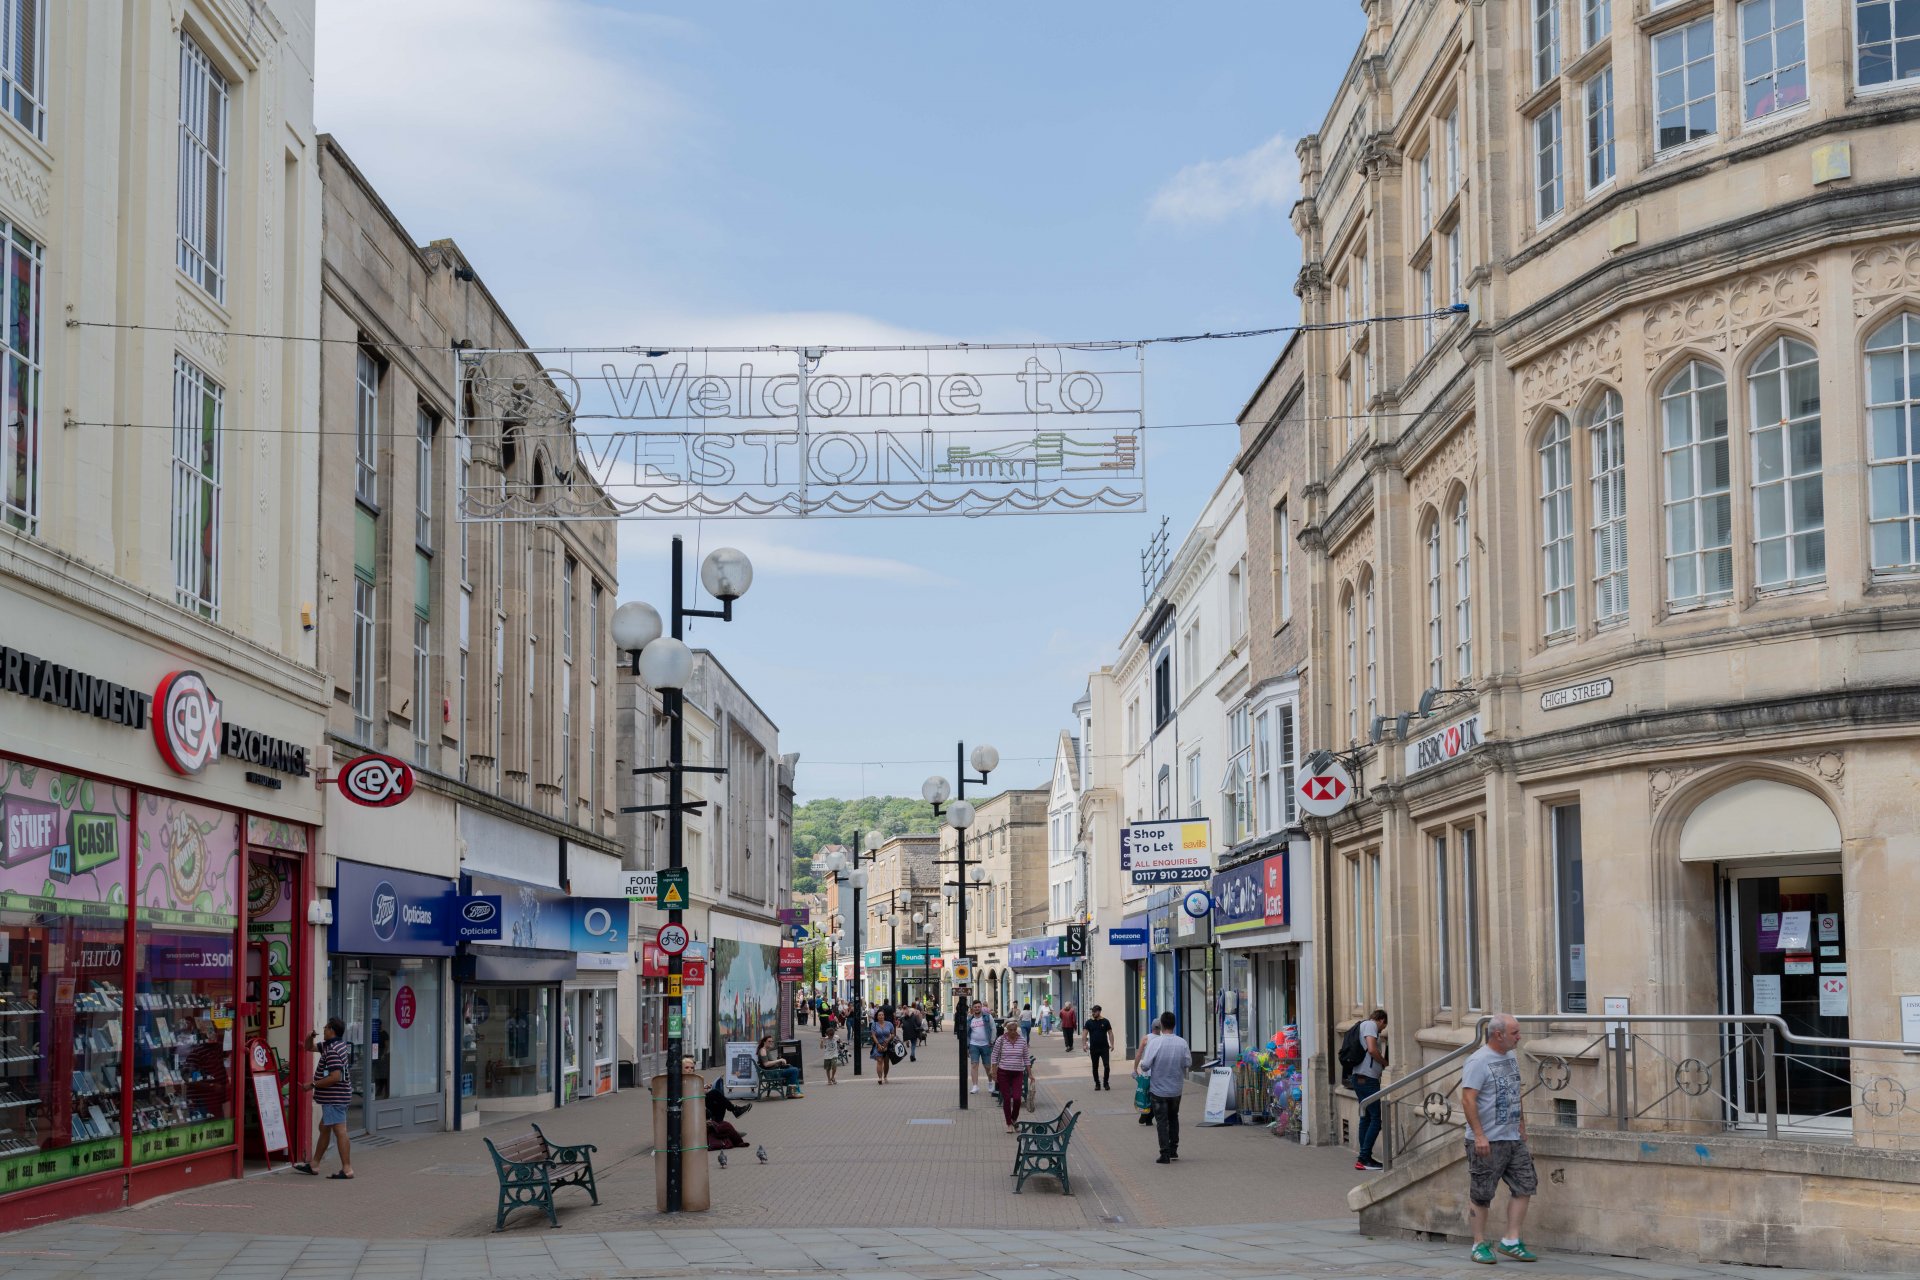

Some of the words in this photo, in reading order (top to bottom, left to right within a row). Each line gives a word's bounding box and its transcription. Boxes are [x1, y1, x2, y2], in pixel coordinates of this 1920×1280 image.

[602, 362, 982, 418] Welcome
[1016, 357, 1103, 413] to
[535, 429, 933, 487] WESTON
[0, 646, 152, 730] RTAINMENT
[1545, 691, 1567, 707] HIGH
[1572, 681, 1607, 701] STREET
[227, 722, 311, 777] EXCHANGE
[1418, 733, 1444, 769] HSBC
[1460, 717, 1479, 750] UK
[9, 814, 51, 849] STUFF
[78, 823, 114, 856] CASH
[1134, 829, 1165, 839] Shop
[1134, 844, 1150, 853] To
[1154, 842, 1174, 852] Let
[1183, 840, 1207, 849] savills
[54, 850, 68, 868] for
[1153, 858, 1198, 867] ENQUIRIES
[1135, 871, 1156, 881] 0117
[1160, 871, 1178, 880] 910
[1181, 869, 1208, 879] 2200
[625, 886, 657, 895] REVIV
[374, 894, 395, 926] Boots
[402, 904, 432, 926] Opticians
[467, 905, 491, 918] Boots
[460, 928, 498, 936] Opticians
[1071, 932, 1081, 951] S
[1212, 1069, 1231, 1079] Mercury
[22, 1165, 33, 1177] SELL
[37, 1160, 57, 1173] DONATE
